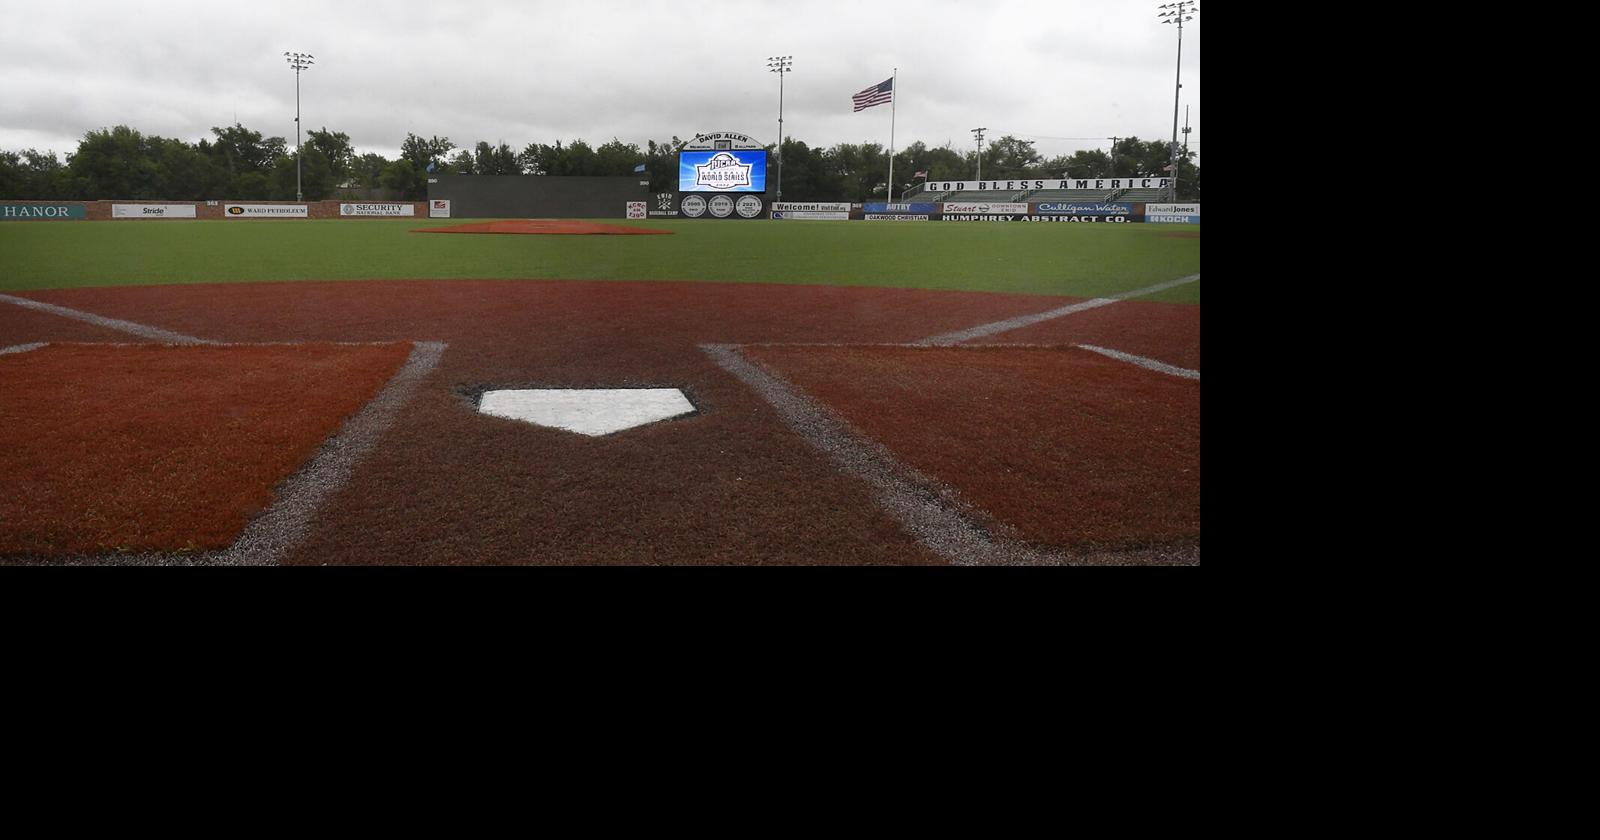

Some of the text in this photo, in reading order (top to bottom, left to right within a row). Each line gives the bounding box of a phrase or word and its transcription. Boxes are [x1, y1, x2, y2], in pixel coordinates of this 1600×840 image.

[699, 134, 748, 142] DAVID ALLEN
[978, 181, 1044, 190] BLESS
[1060, 178, 1168, 188] AMERICA
[4, 206, 69, 216] HANOR
[1039, 204, 1094, 213] Culligan
